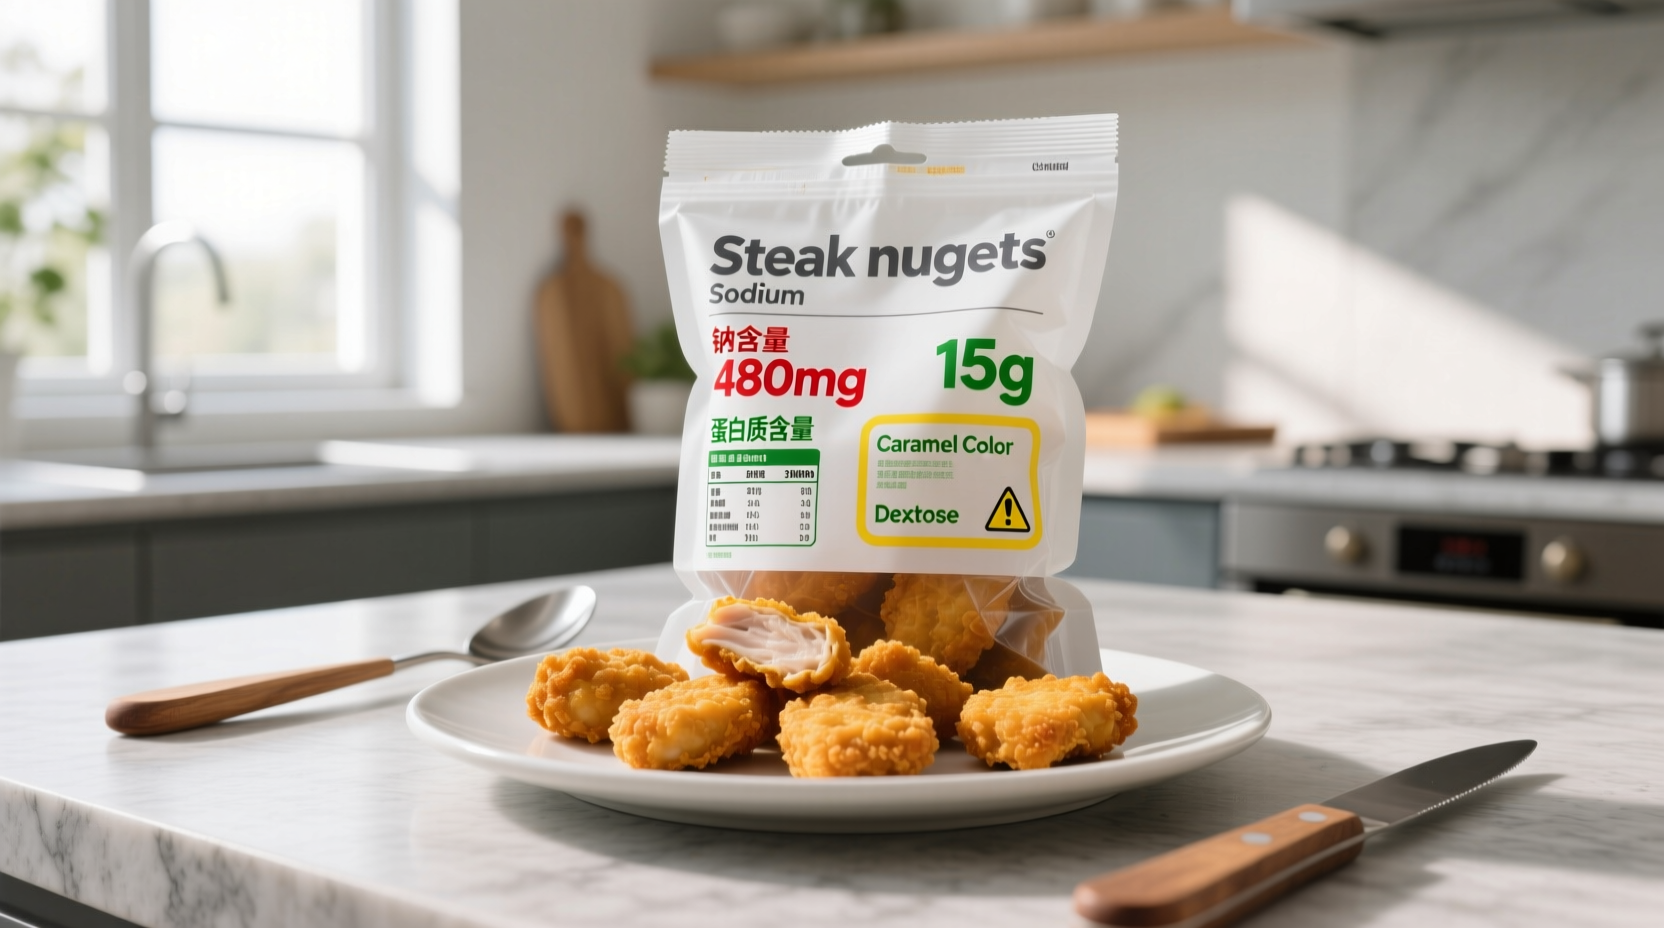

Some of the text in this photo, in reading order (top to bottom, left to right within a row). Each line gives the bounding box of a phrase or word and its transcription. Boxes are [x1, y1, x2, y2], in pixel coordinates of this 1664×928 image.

[710, 232, 1047, 287] Steak nugets
[710, 281, 804, 306] Sodium
[712, 324, 790, 354] 钠含量
[713, 357, 867, 408] 480mg
[936, 338, 1034, 406] 15g
[711, 415, 815, 443] 蛋白质含量
[877, 434, 1014, 455] Caramel Color
[875, 504, 959, 524] Dextose
